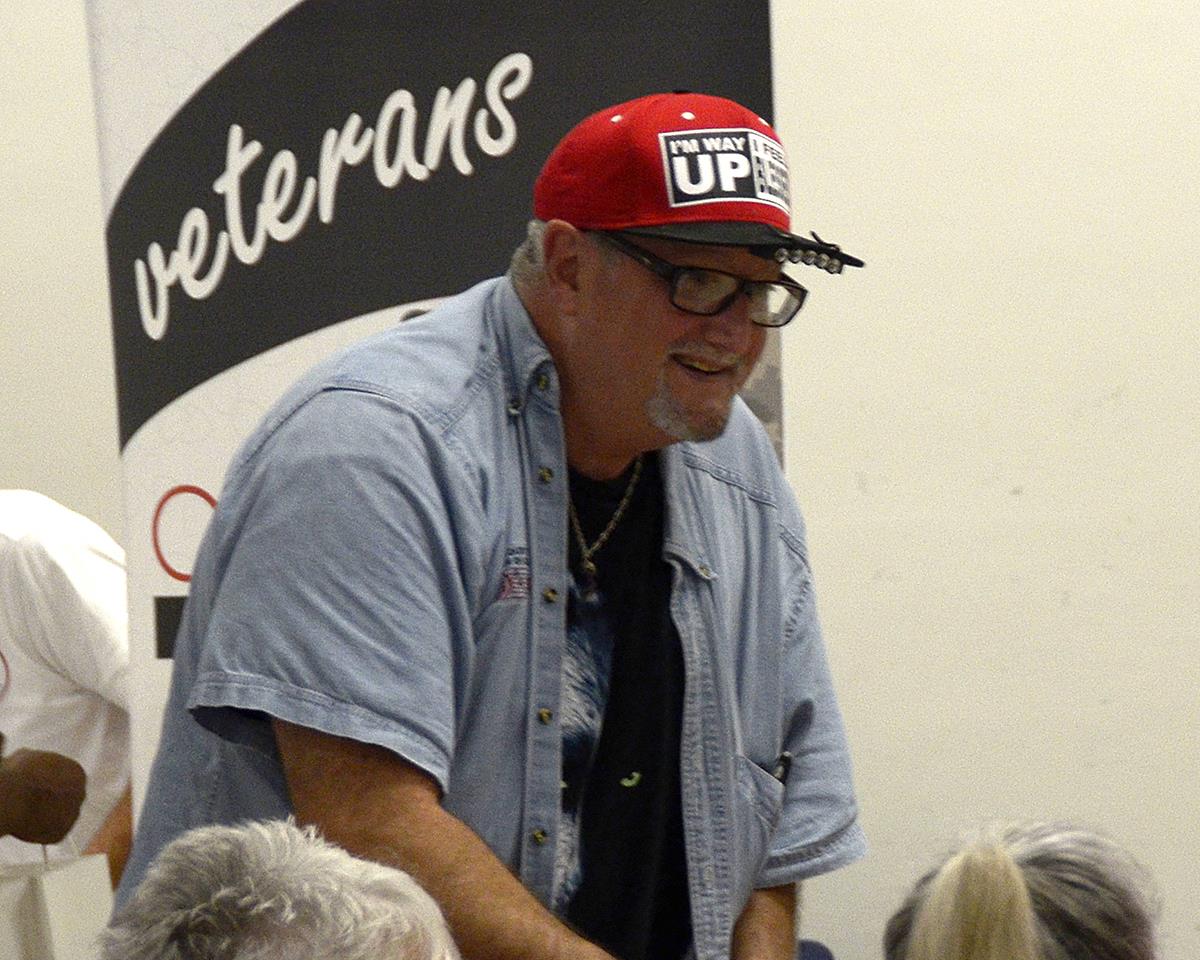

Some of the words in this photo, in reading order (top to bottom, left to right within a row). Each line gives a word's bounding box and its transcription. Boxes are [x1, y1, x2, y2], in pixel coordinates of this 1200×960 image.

[669, 138, 700, 155] I'M
[703, 137, 746, 152] WAY
[672, 153, 750, 195] UP
[134, 52, 534, 342] veterans
